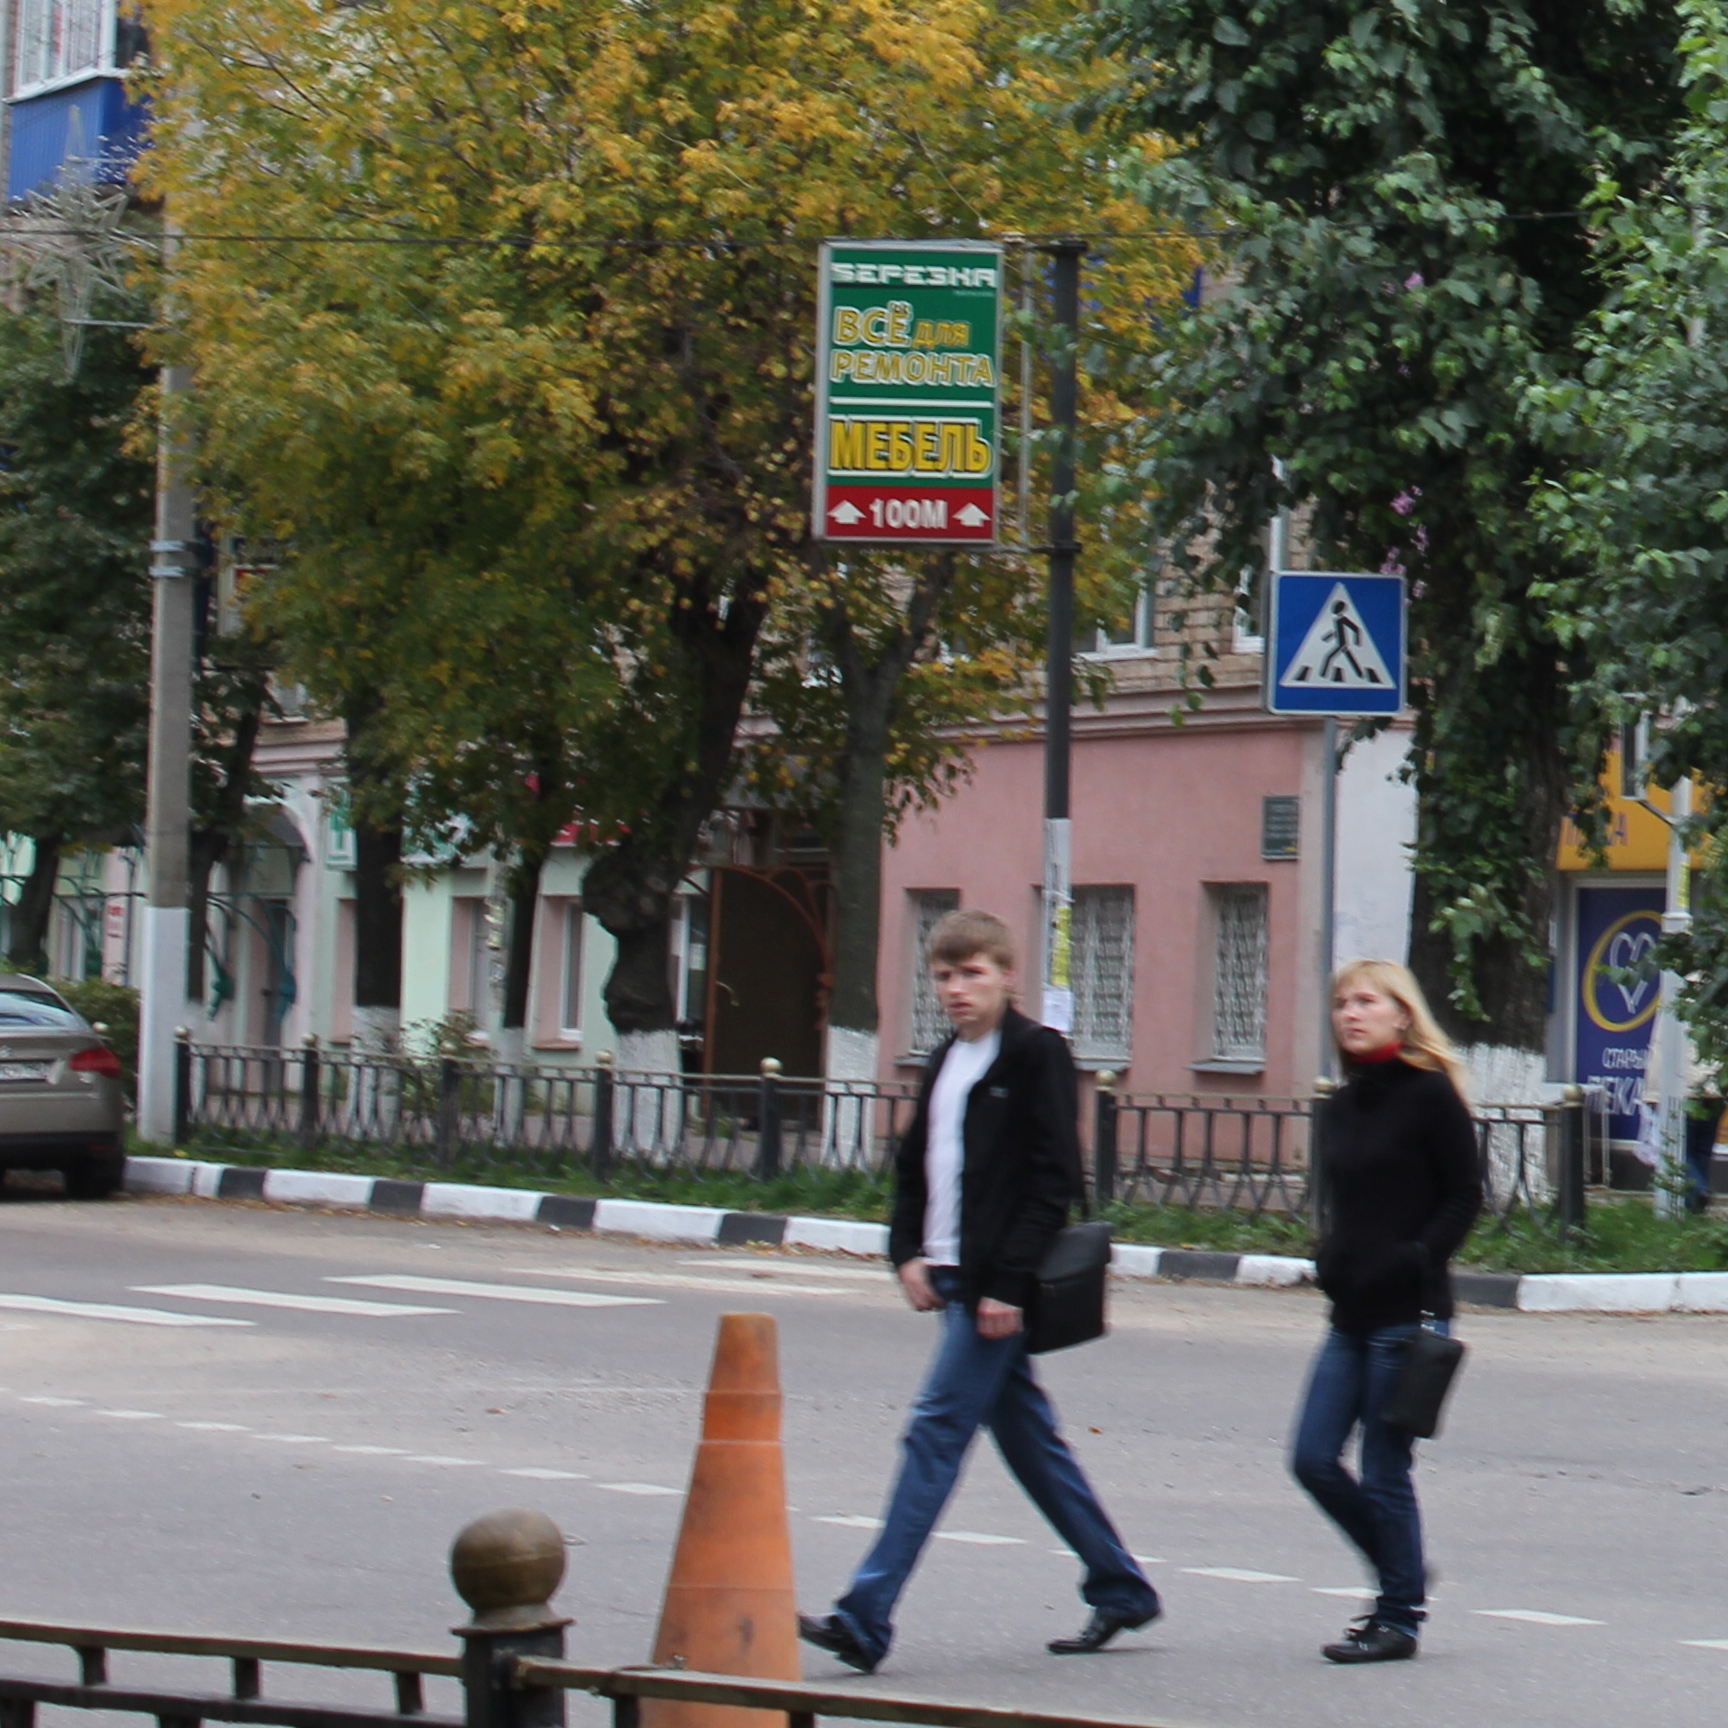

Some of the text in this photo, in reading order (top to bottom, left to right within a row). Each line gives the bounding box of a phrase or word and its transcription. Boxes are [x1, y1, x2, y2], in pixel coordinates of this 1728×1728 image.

[833, 300, 913, 348] ВСЁ
[830, 349, 997, 387] РЕМОНТА
[829, 416, 993, 476] МЕБЕЛЬ
[869, 498, 948, 529] 100М
